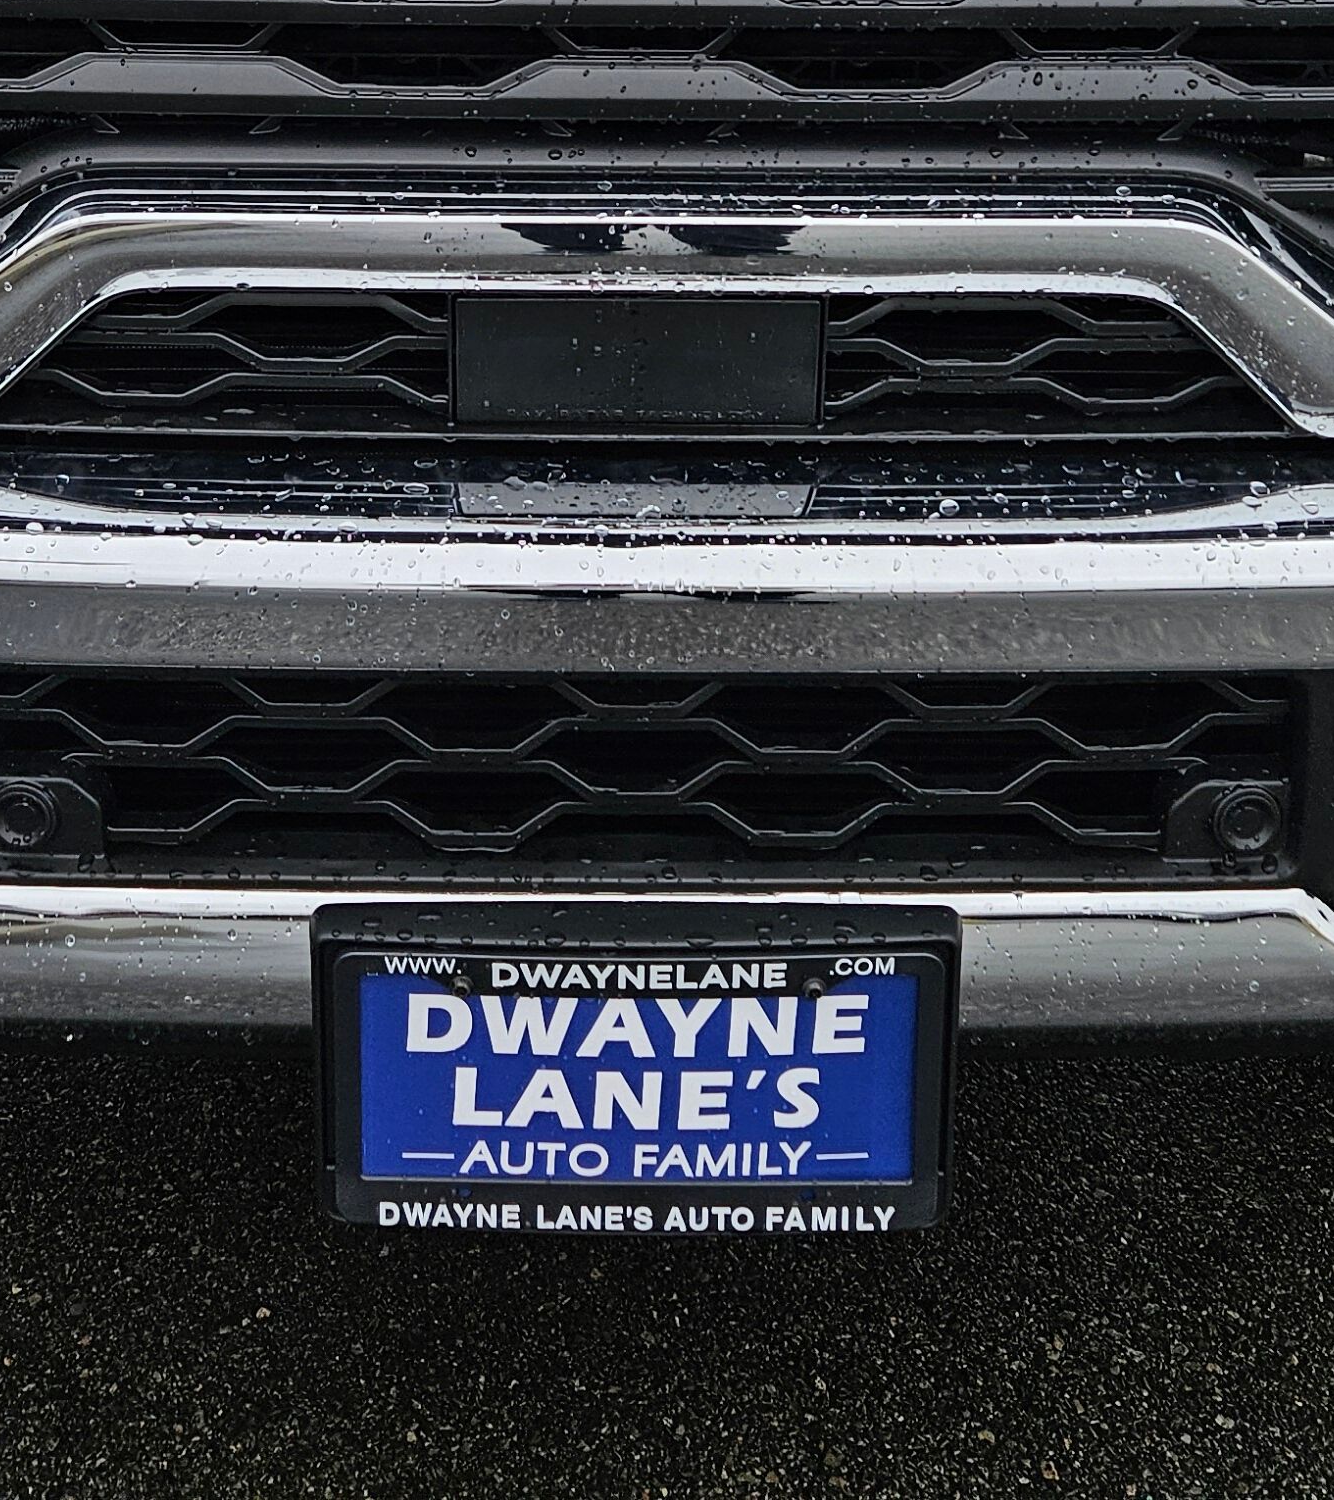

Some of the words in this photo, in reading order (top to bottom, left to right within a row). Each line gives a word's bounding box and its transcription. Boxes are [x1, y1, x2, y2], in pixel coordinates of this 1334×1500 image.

[491, 962, 788, 990] DWAYNELANE
[829, 956, 897, 976] .COM
[406, 994, 870, 1058] DWAYNE
[452, 1066, 821, 1131] LANE'S
[458, 1139, 610, 1178] AUTO
[633, 1140, 813, 1178] FAMILY
[378, 1201, 522, 1230] DWAYNE
[536, 1203, 655, 1232] LANE'S
[663, 1205, 756, 1232] AUTO
[766, 1205, 897, 1232] FAMILY
